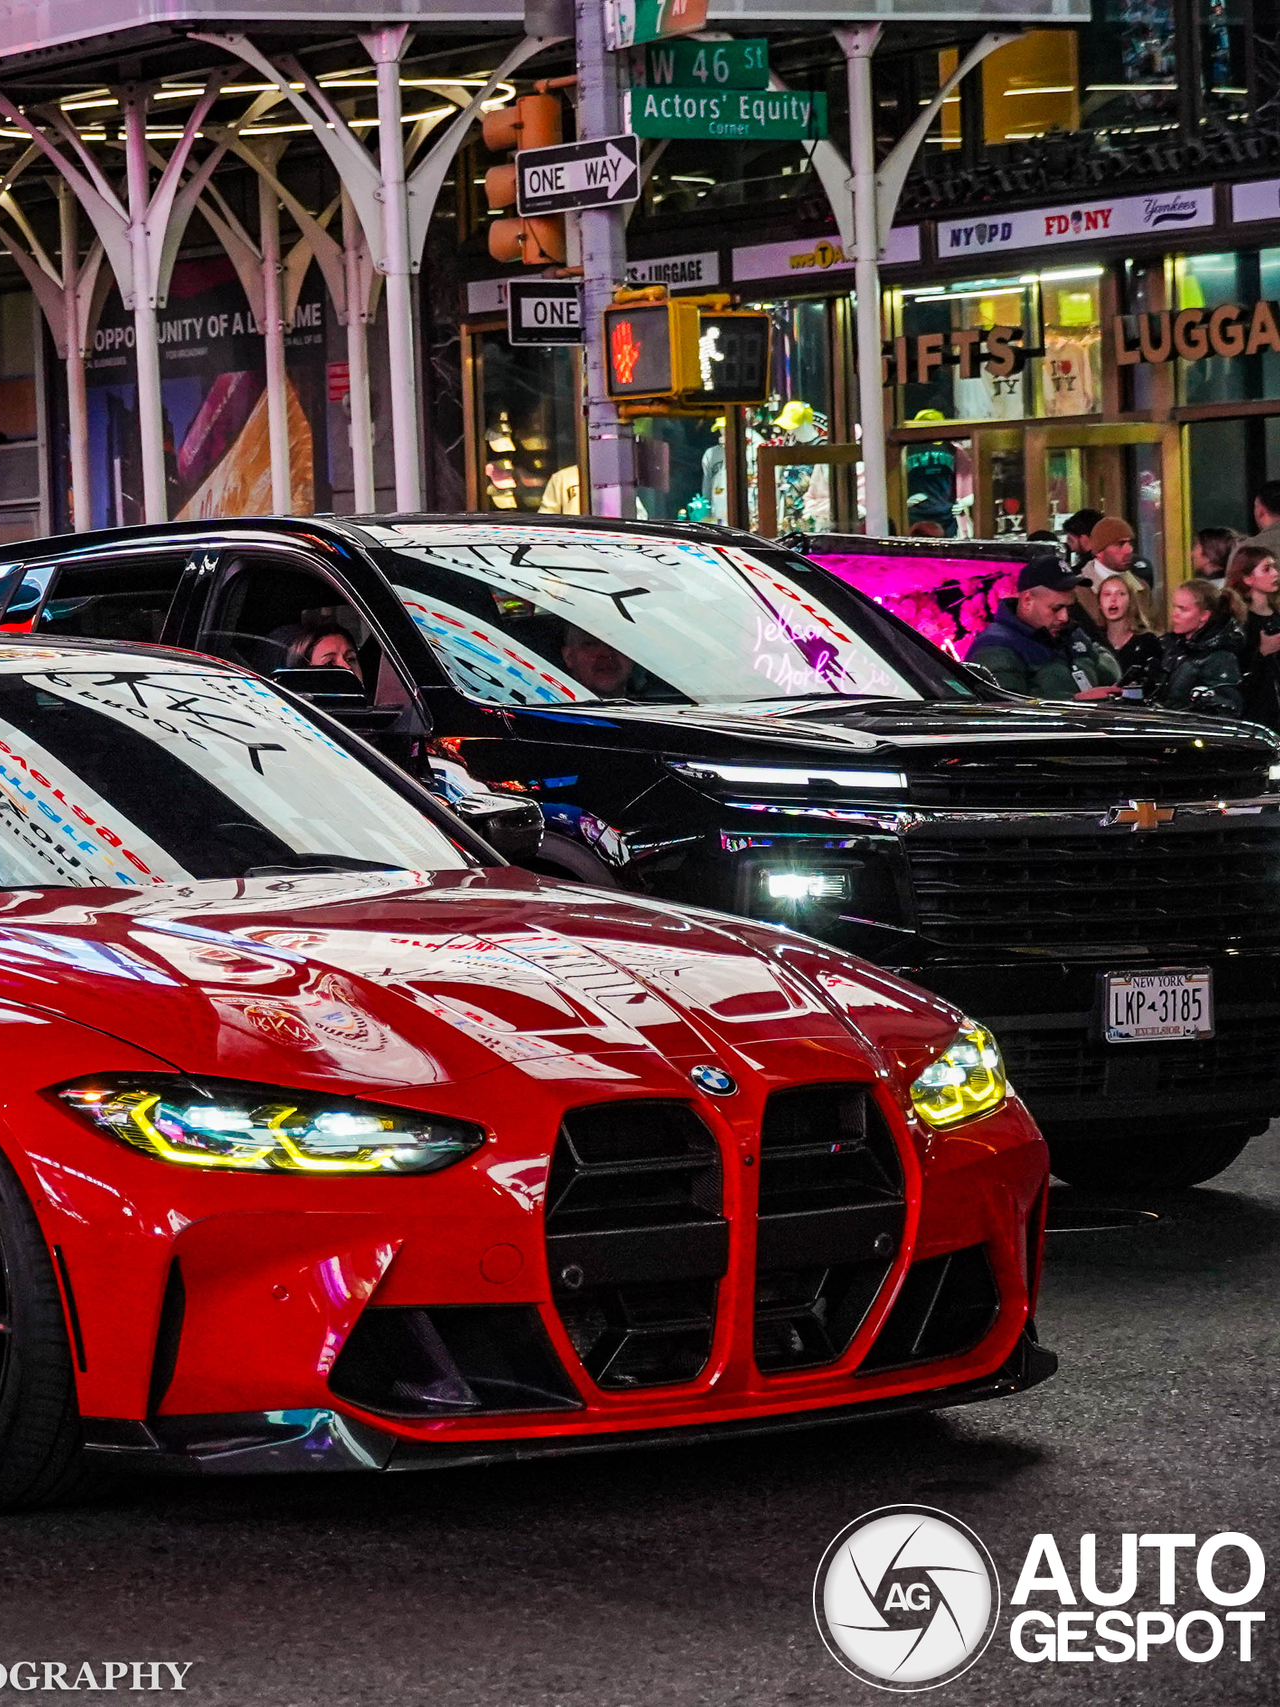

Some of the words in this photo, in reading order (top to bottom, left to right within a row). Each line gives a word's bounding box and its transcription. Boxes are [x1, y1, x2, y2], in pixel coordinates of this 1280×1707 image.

[651, 50, 675, 85] W
[692, 48, 729, 83] 46
[744, 45, 764, 70] St
[644, 94, 727, 120] Actors'
[739, 95, 812, 127] Equity
[708, 121, 751, 136] Corner
[529, 167, 566, 195] ONE
[584, 157, 622, 188] WAY
[1143, 195, 1198, 224] Yankees
[648, 260, 703, 283] LUGGAGE
[533, 300, 579, 325] ONE
[95, 315, 204, 351] OPPOUNITY
[207, 314, 228, 338] OF
[232, 312, 245, 335] A
[882, 326, 1017, 386] IFTS
[1132, 976, 1155, 989] NEW
[1157, 974, 1185, 988] YORK
[1115, 991, 1146, 1026] LKP
[1159, 988, 1202, 1023] 3185
[1135, 1026, 1181, 1037] EXCELSIOR
